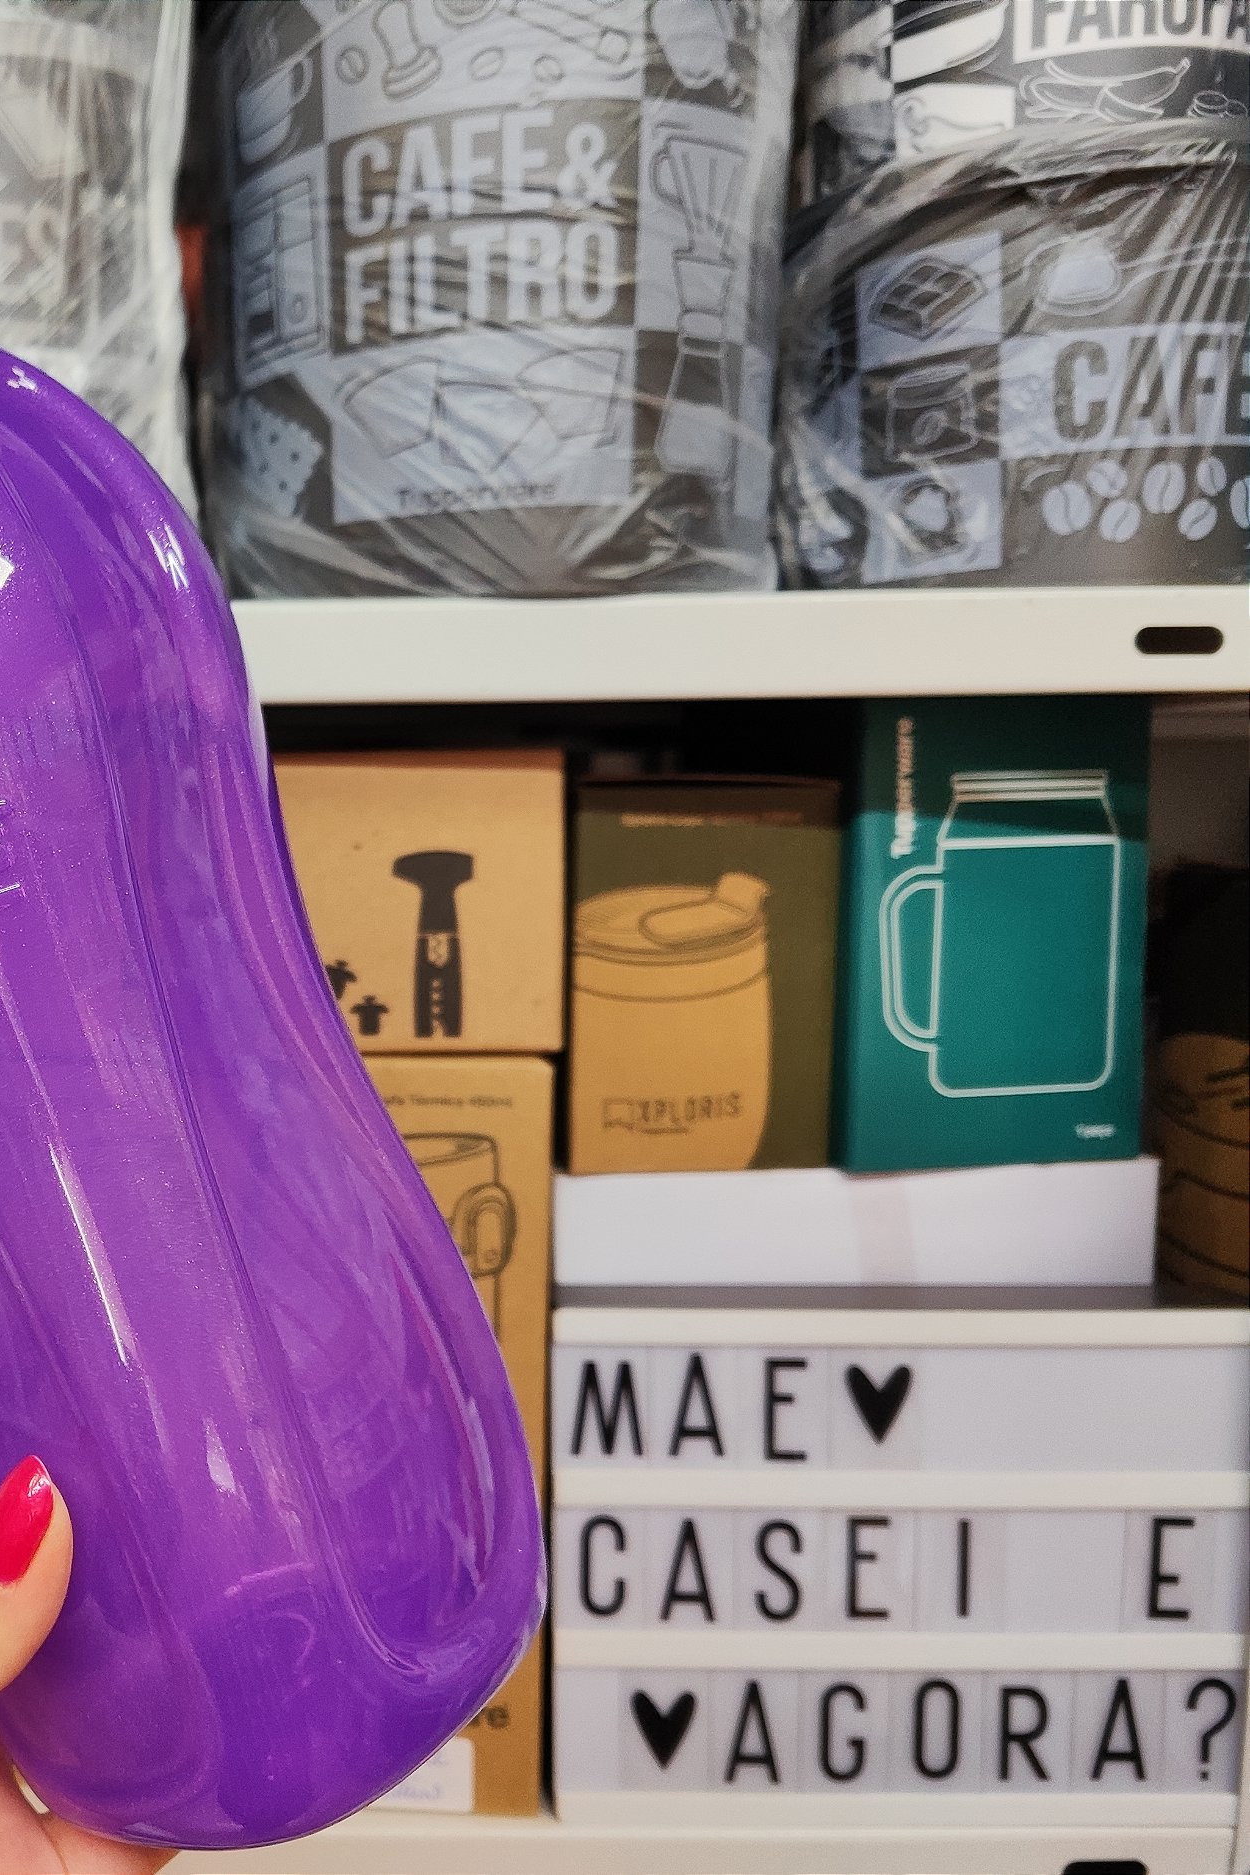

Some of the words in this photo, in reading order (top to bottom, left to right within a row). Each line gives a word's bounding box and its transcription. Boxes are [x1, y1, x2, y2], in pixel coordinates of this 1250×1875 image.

[556, 122, 618, 209] &
[344, 221, 619, 345] FILTRO
[570, 1353, 808, 1461] MAE
[578, 1515, 972, 1621] CASEI
[1145, 1516, 1196, 1620] E
[724, 1677, 1238, 1784] AGORA?
